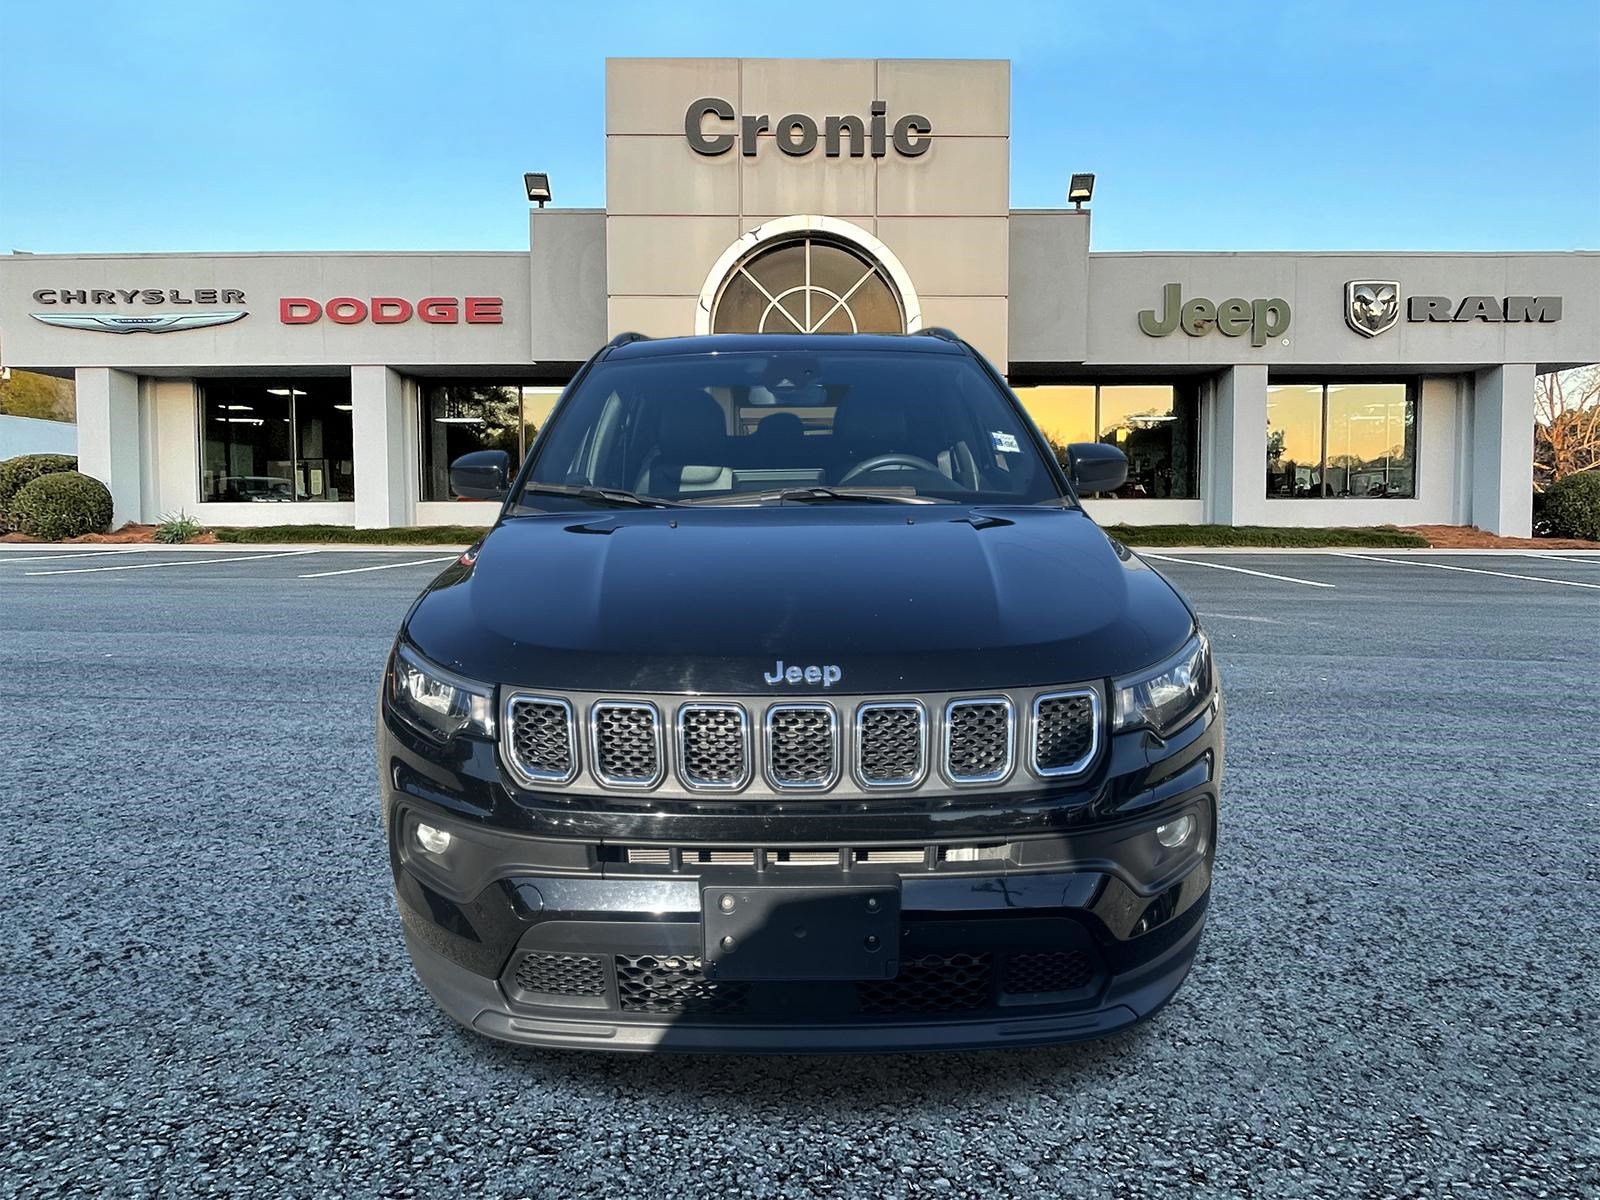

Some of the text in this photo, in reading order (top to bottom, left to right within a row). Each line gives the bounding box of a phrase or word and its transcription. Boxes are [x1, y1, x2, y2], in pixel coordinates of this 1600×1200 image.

[685, 97, 932, 157] Cronic
[32, 289, 247, 304] CHRYSLER
[1407, 296, 1563, 322] RAM
[279, 297, 504, 324] DODGE
[1138, 283, 1291, 347] Jeep
[764, 660, 841, 687] Jeep
